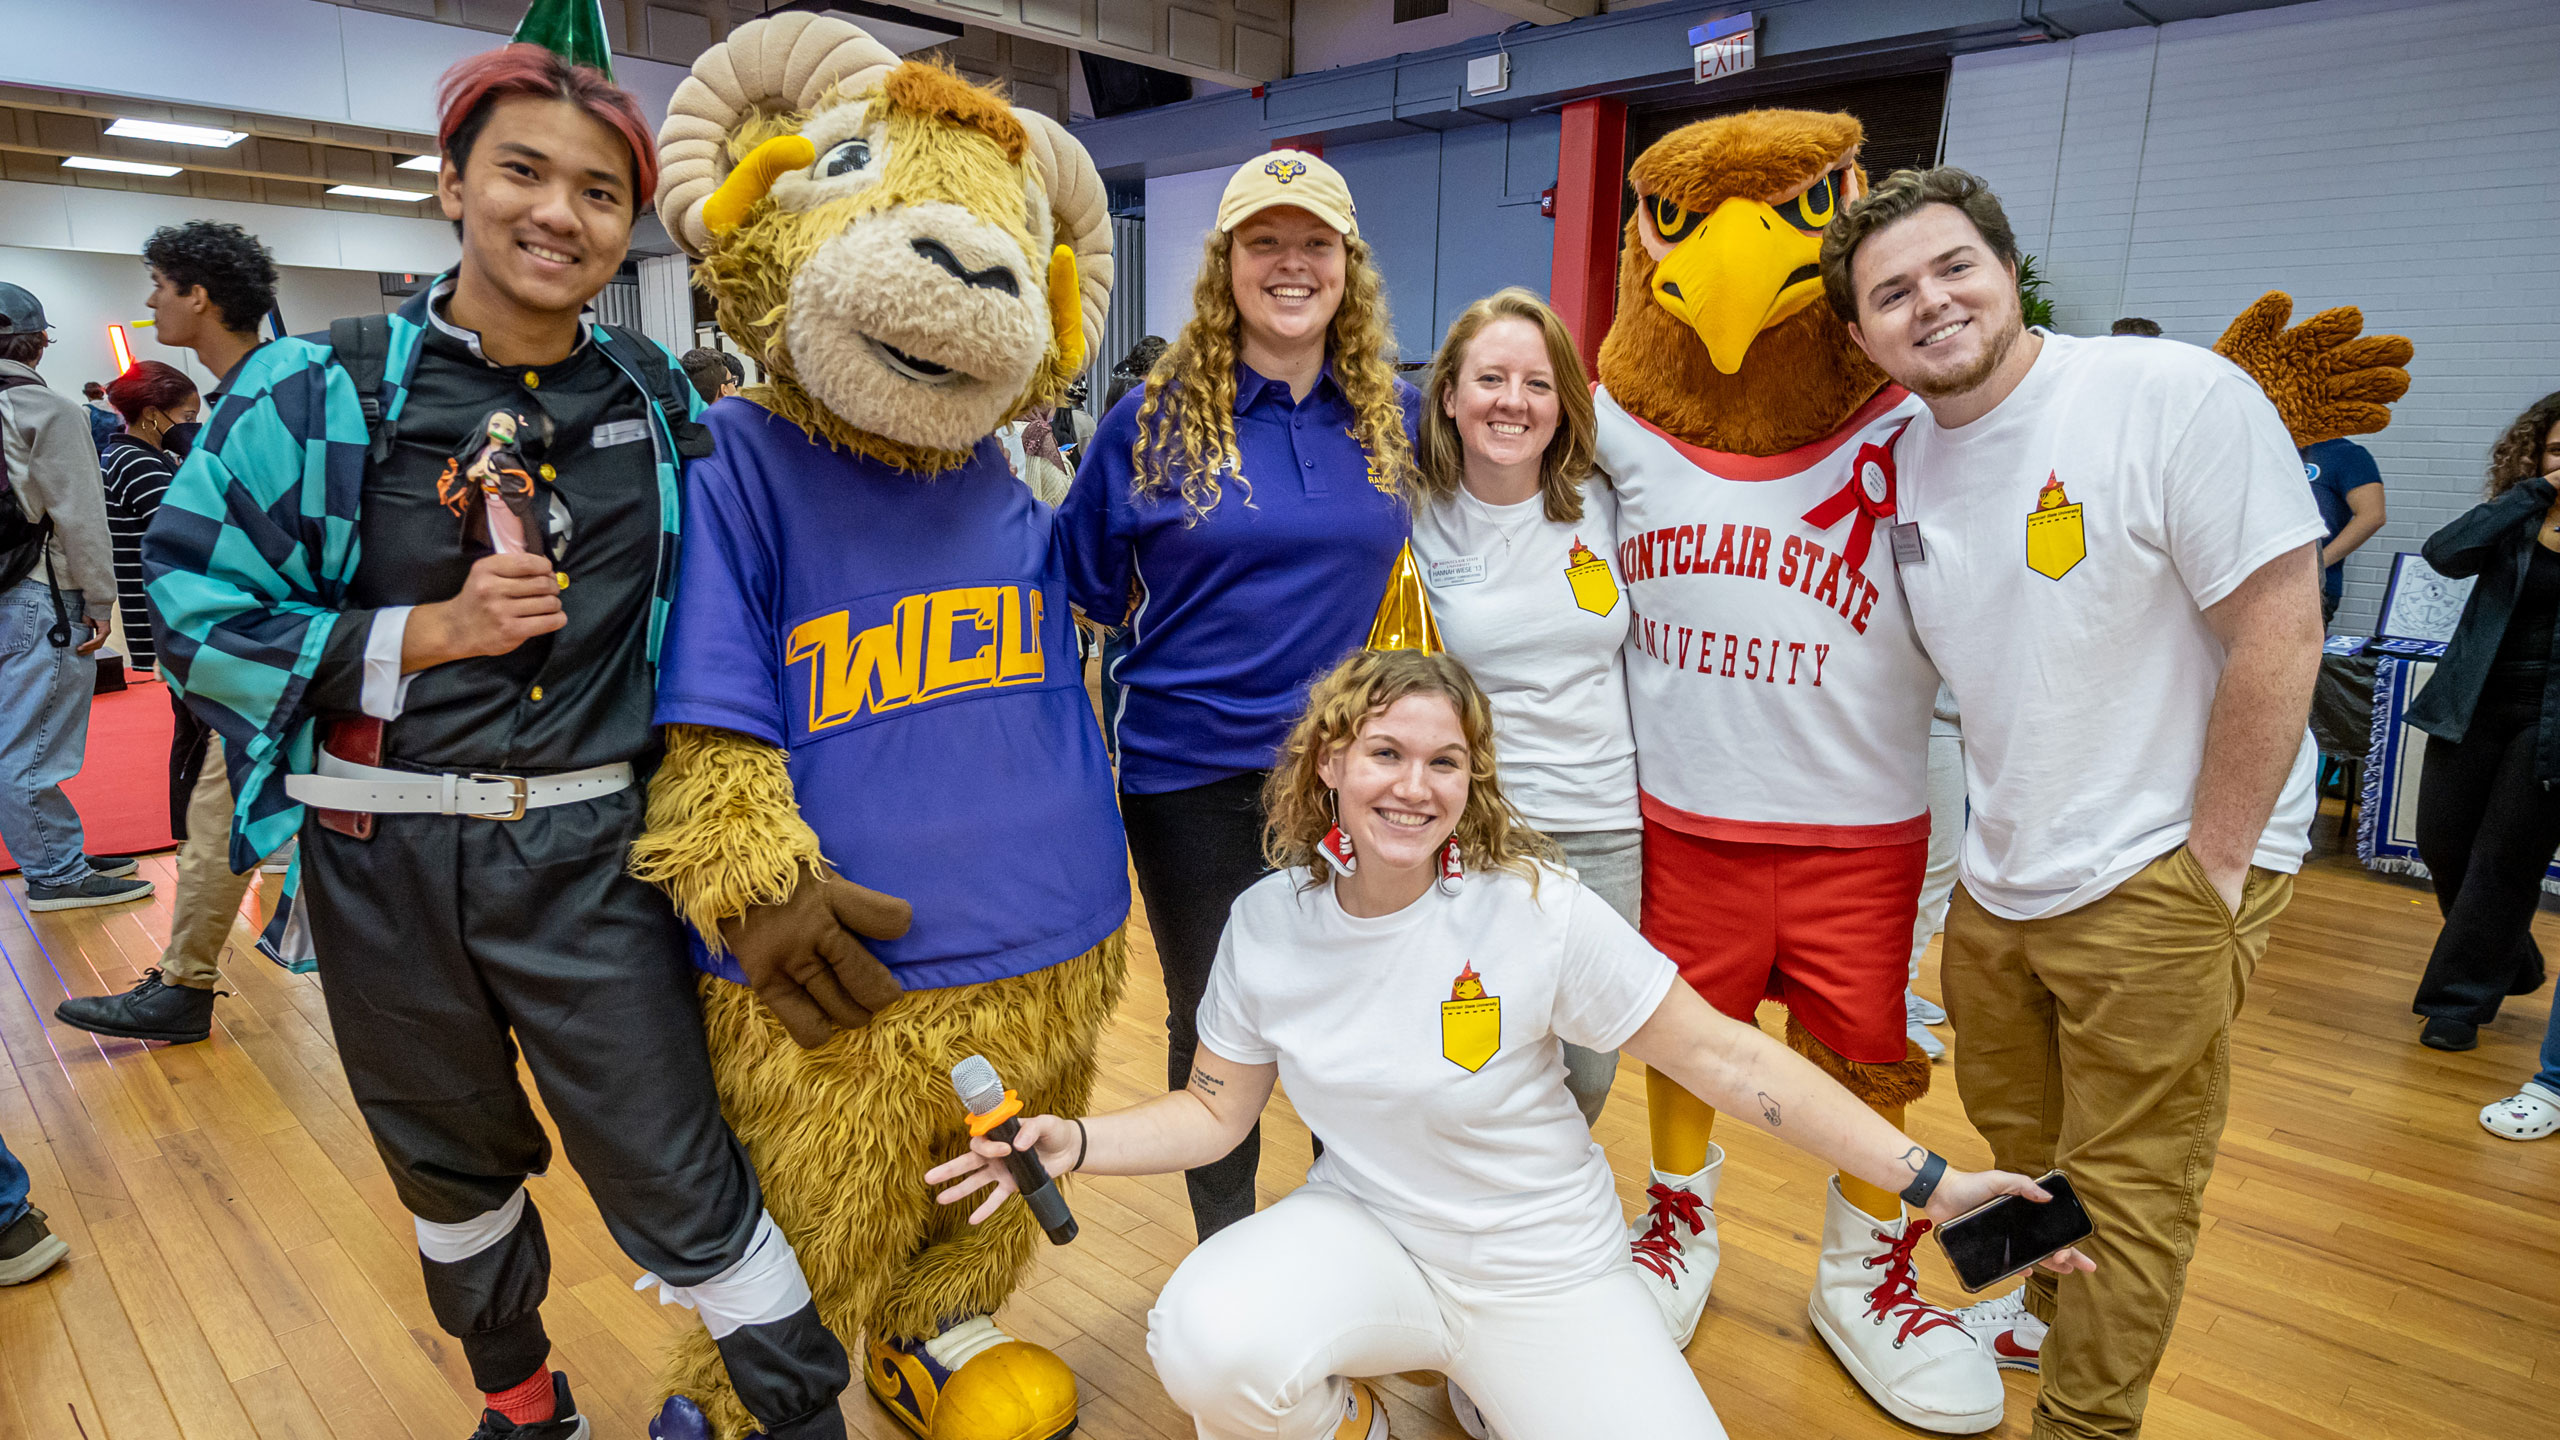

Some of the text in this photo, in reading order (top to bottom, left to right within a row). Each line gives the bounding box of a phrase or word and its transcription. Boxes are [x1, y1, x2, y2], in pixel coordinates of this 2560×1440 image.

[1700, 34, 1749, 79] EXIT
[1432, 568, 1455, 577] HANNAH
[1778, 534, 1880, 636] STATE
[786, 586, 1044, 733] WCU
[1632, 610, 1830, 688] UNIVERSITY
